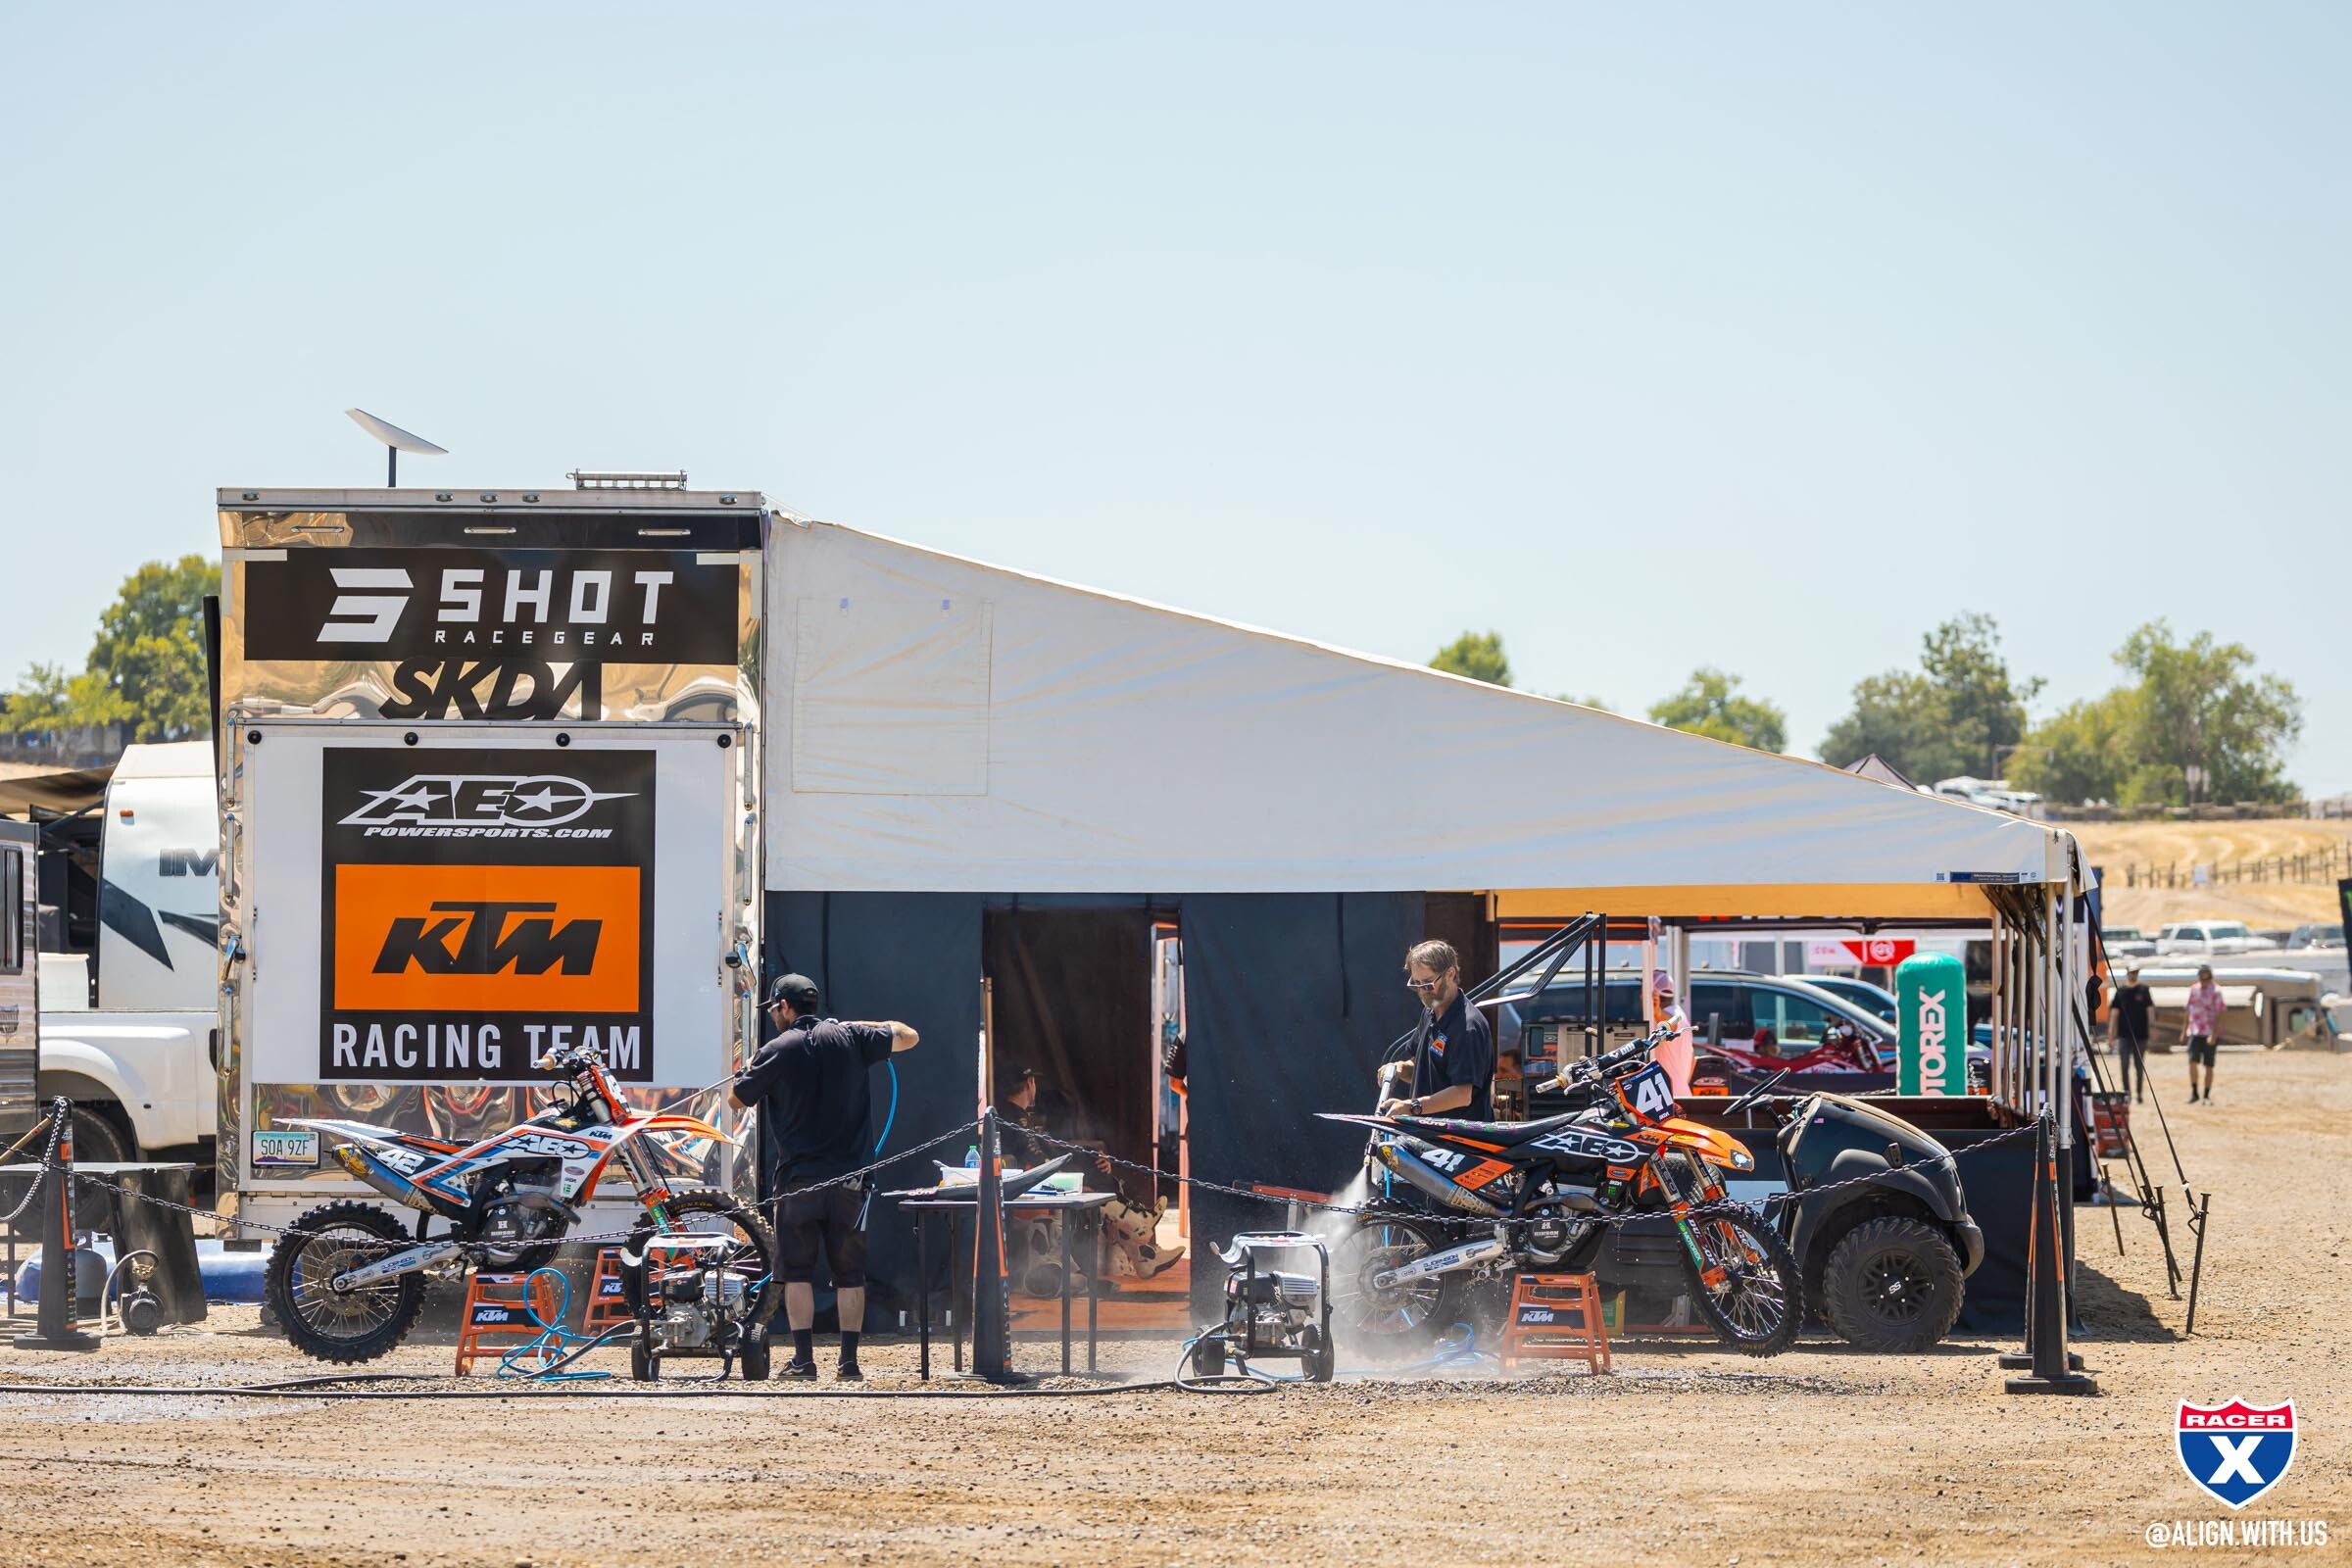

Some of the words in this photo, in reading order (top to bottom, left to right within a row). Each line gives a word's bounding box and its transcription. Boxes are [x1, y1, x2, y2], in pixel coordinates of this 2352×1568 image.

[437, 568, 674, 624] SHOT
[435, 629, 656, 646] RACEGEAR
[337, 774, 598, 827] AEO
[364, 826, 612, 839] POWERSPORTS.COM
[372, 901, 603, 975] KTM
[333, 1023, 502, 1069] RACING
[523, 1024, 641, 1070] TEAM
[1636, 1072, 1674, 1114] 41
[287, 1139, 310, 1155] 9ZF
[499, 1132, 592, 1159] AEO
[589, 1130, 612, 1140] KTM
[1530, 1131, 1640, 1163] AEO
[1637, 1134, 1660, 1144] KTM
[376, 1149, 426, 1175] 42
[1421, 1148, 1466, 1172] 41
[603, 1282, 623, 1294] KT
[475, 1309, 509, 1322] KTM
[1521, 1310, 1554, 1323] KTM
